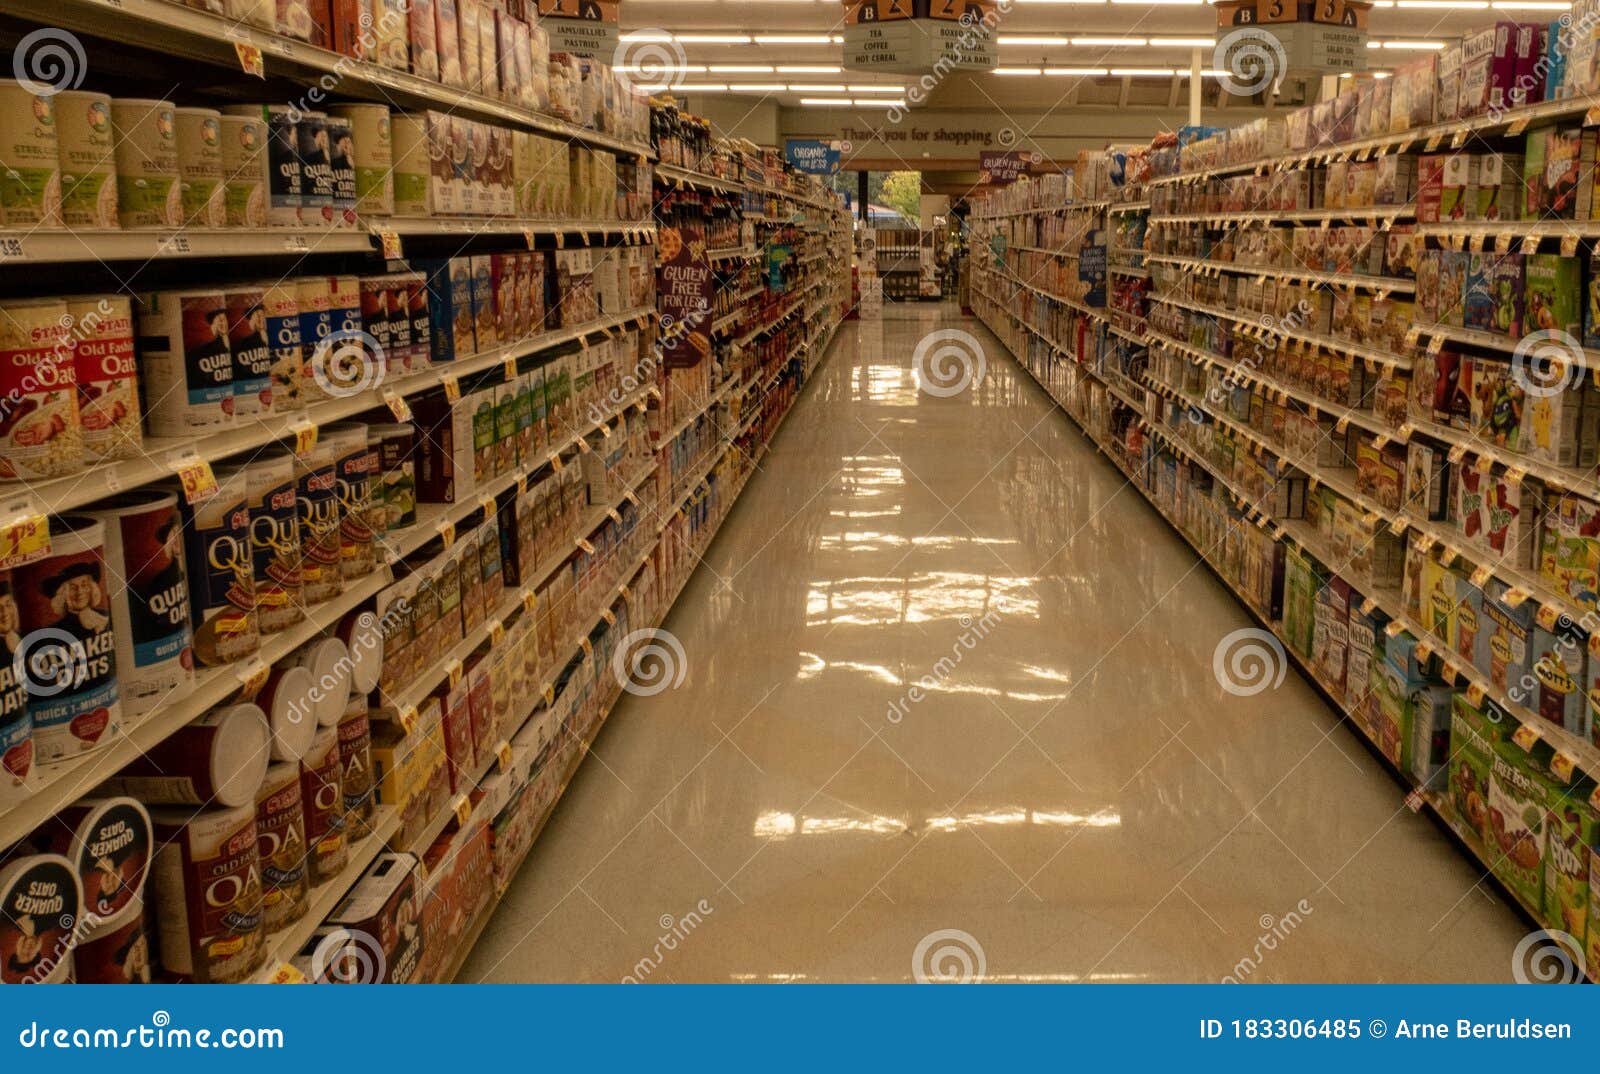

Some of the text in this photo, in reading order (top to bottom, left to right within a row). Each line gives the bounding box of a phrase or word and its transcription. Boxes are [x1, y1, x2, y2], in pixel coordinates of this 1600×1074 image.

[585, 5, 598, 18] A
[864, 7, 875, 20] B
[1240, 10, 1251, 23] B
[1269, 0, 1283, 19] 3
[1324, 0, 1335, 19] 3
[1344, 12, 1354, 25] A
[870, 30, 882, 38] TEA
[564, 39, 600, 49] PASTRIES
[864, 41, 889, 51] COFFEE
[855, 53, 897, 64] HOT CEREAL
[841, 128, 993, 148] Thank you for shopping
[793, 144, 828, 159] ORGANIC
[663, 266, 708, 283] GLUTEN
[672, 280, 704, 296] FREE
[664, 294, 684, 308] FOR
[80, 343, 106, 357] Old
[13, 353, 43, 367] Old
[1537, 666, 1572, 690] MOTT'S
[35, 707, 69, 722] QUICK
[99, 820, 126, 839] OATS
[90, 827, 134, 858] QUAKER
[212, 862, 240, 877] OLD
[28, 881, 57, 899] OATS
[13, 893, 64, 916] QUAKER
